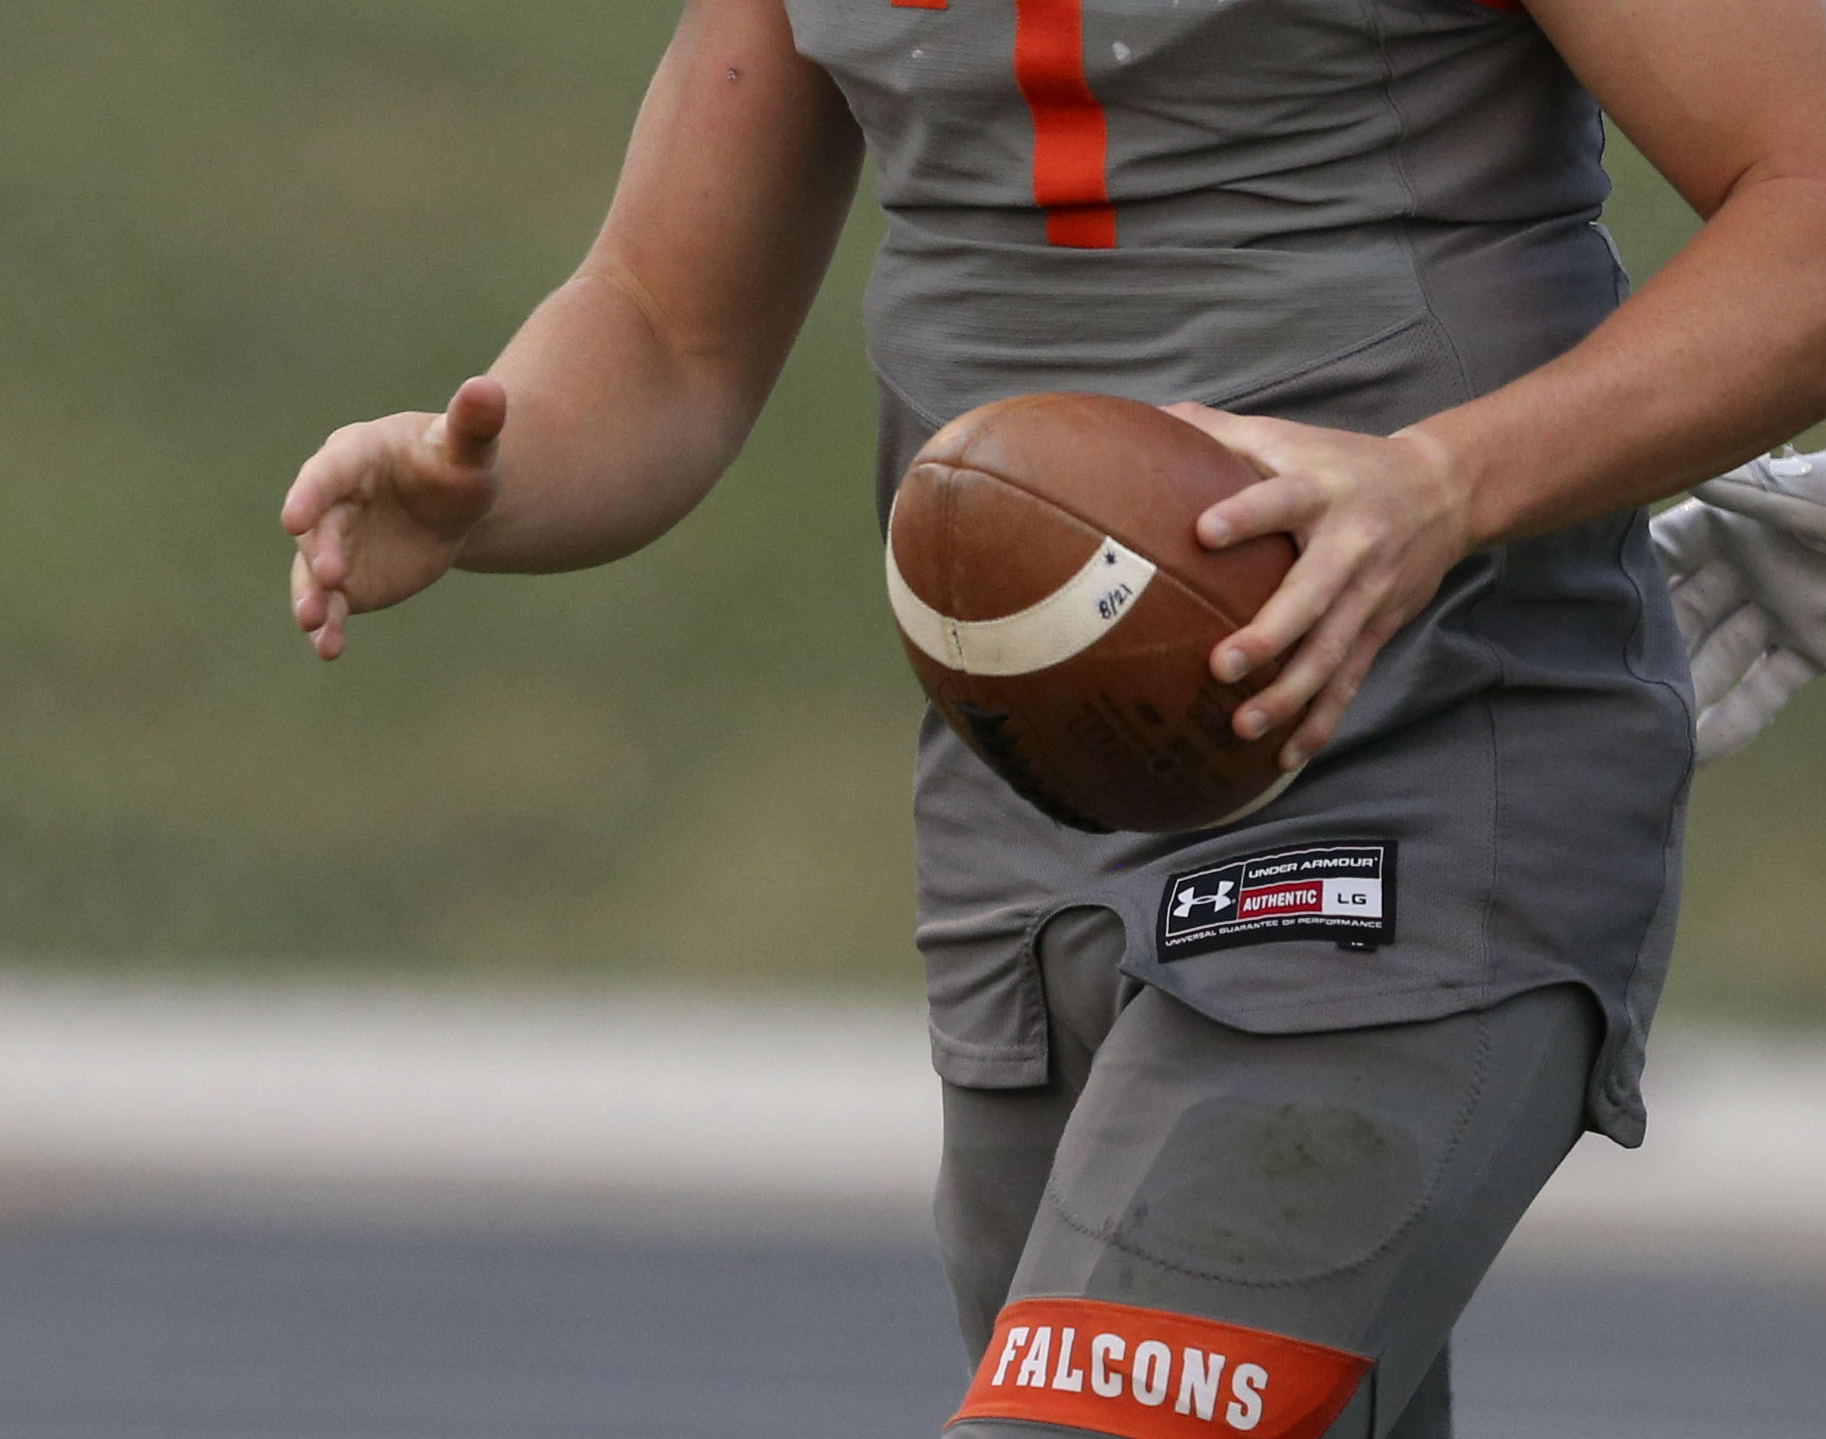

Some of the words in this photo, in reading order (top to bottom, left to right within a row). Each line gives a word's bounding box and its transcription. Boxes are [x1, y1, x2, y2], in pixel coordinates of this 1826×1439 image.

[1248, 863, 1297, 879] UNDER
[1300, 857, 1374, 871] ARMOUR
[1243, 889, 1317, 911] AUTHENTIC
[1337, 893, 1368, 906] LG
[1165, 929, 1217, 946] UNIVERSAL
[1219, 919, 1280, 935] GUARANTEE
[1297, 917, 1384, 929] PERFORMANCE
[991, 1326, 1269, 1431] FALCONS
